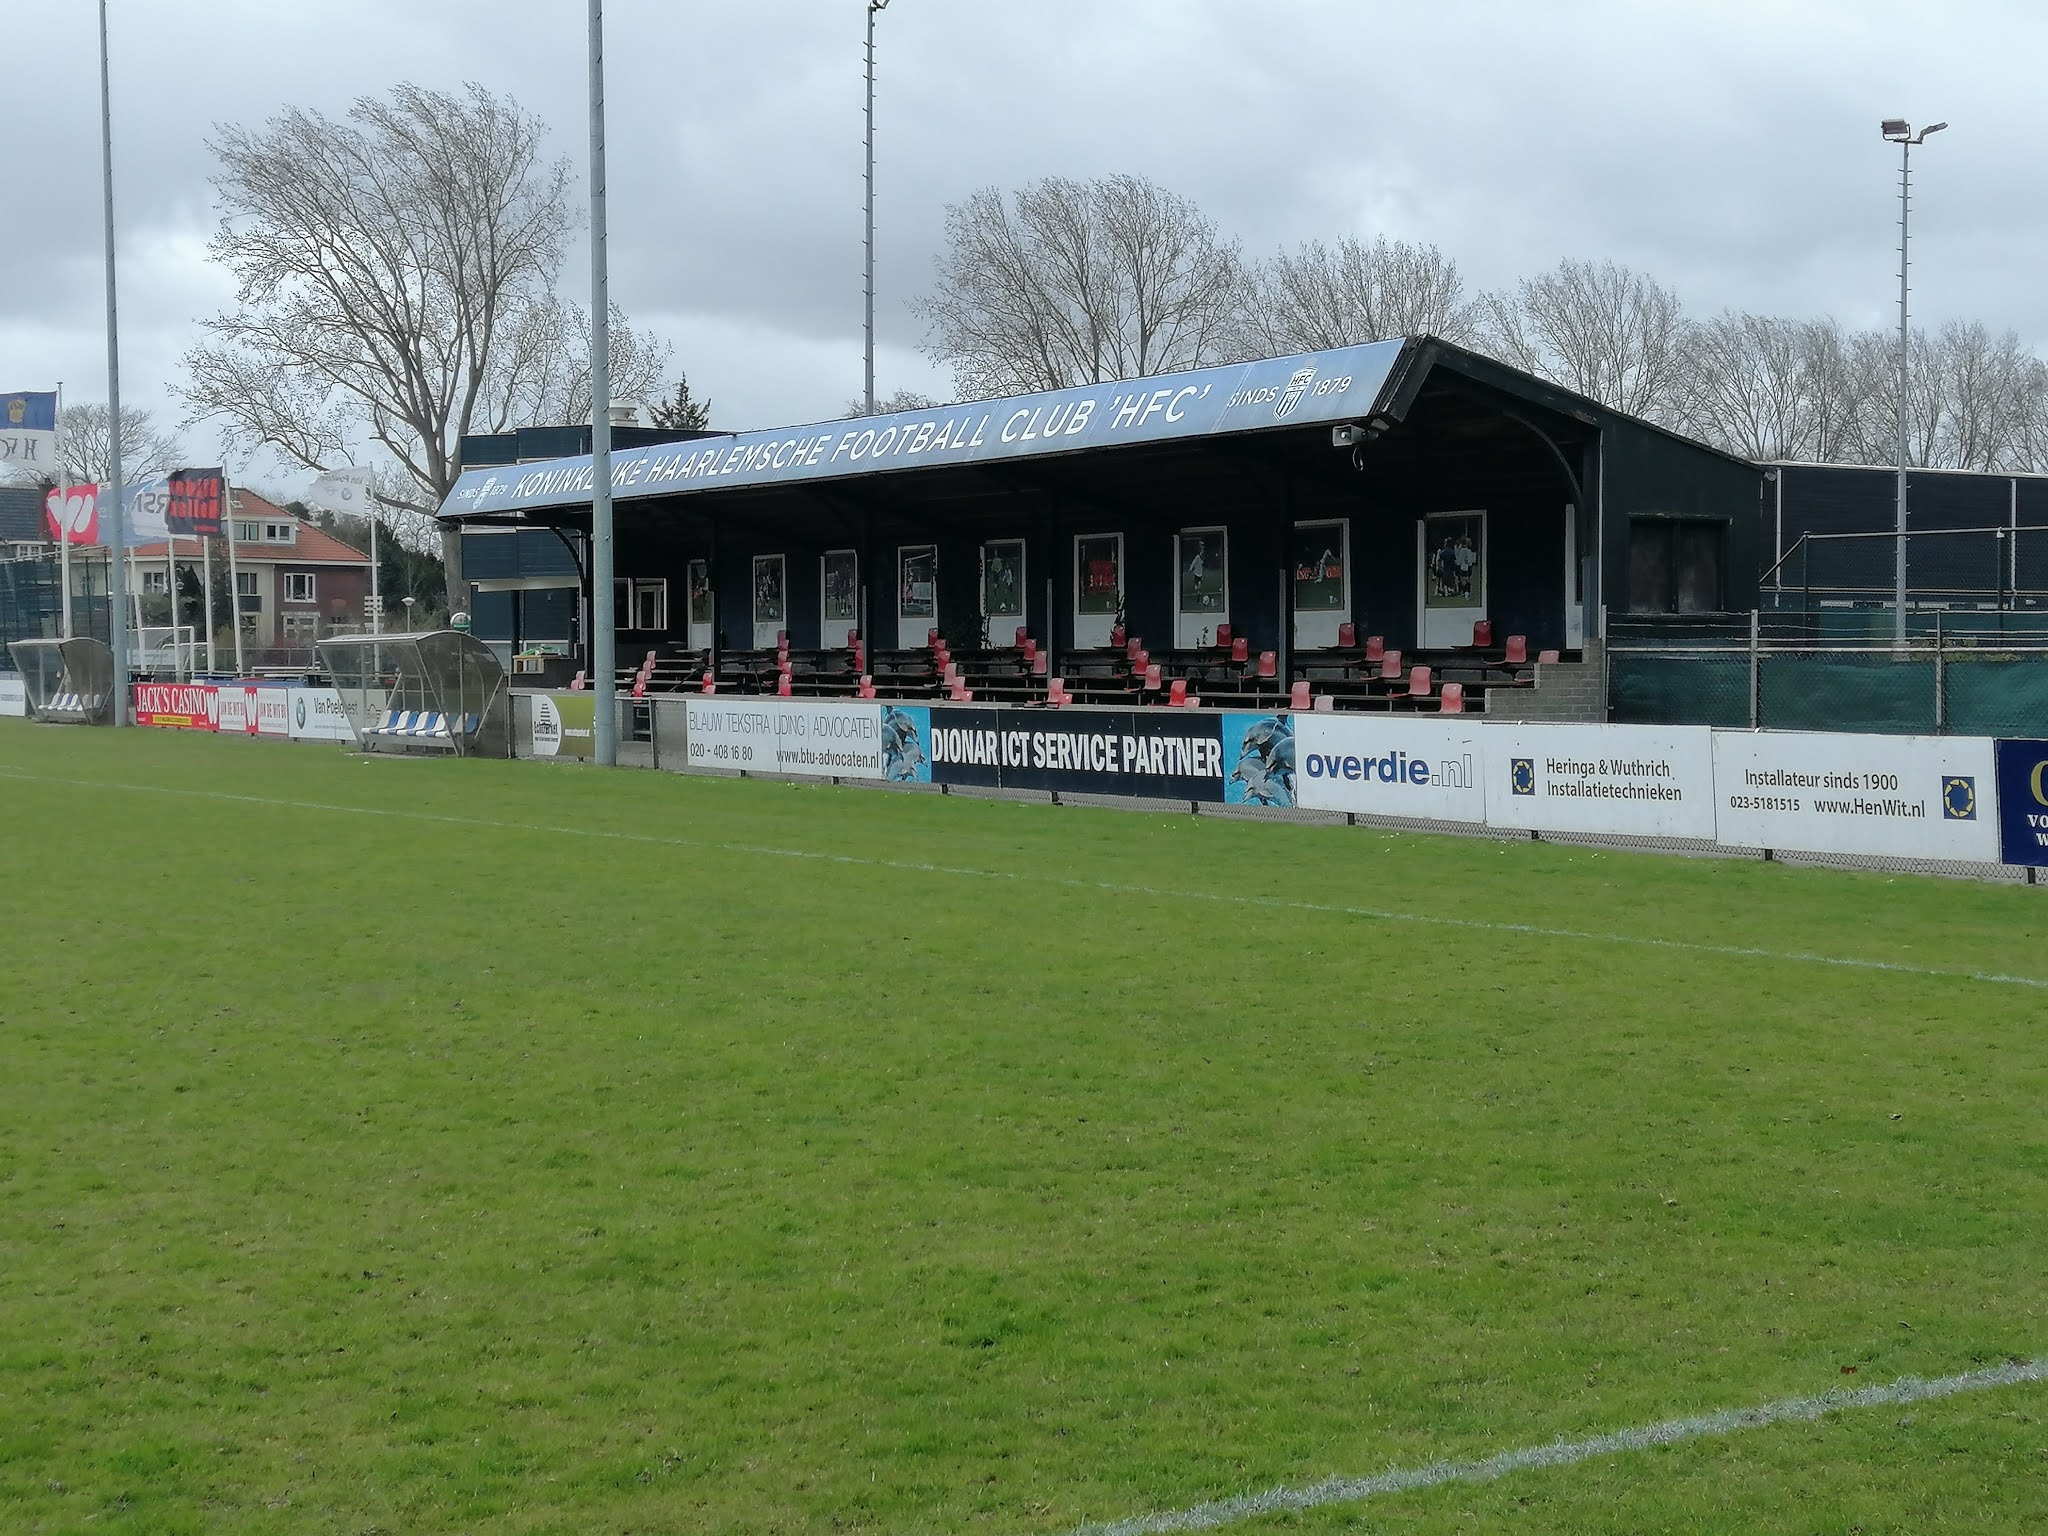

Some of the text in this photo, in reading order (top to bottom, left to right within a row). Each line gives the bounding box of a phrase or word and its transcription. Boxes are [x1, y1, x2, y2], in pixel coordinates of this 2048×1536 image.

[1227, 376, 1352, 408] SINDS 1879
[1290, 374, 1312, 386] HFC
[511, 458, 649, 499] KONINKLKE
[644, 434, 832, 483] HAARLEMSCHE
[830, 414, 990, 463] FOOTBALL
[1000, 399, 1096, 444] CLUB
[137, 686, 207, 715] JACK'S CASINO
[314, 697, 358, 719] Van Poelgest
[690, 711, 722, 731] BLAUW
[725, 712, 771, 734] TEKSTRA
[774, 714, 805, 736] UDING
[813, 716, 879, 740] ADVOCATEN
[690, 743, 705, 757] 020
[713, 744, 728, 759] 408
[731, 745, 740, 760] 16
[742, 746, 753, 761] 80
[776, 747, 880, 769] www.btu-advocaten.nl
[931, 728, 1223, 778] DIONAR ICT SERVICE PARTNER
[1306, 750, 1473, 789] overdie.nl
[1546, 757, 1671, 779] Heringa & Wuthrich
[1745, 768, 1898, 791] Installateur sinds 1900
[1547, 780, 1682, 802] Installatietechnieken
[1730, 796, 1926, 819] 023-5181515 www.HenWit.nl
